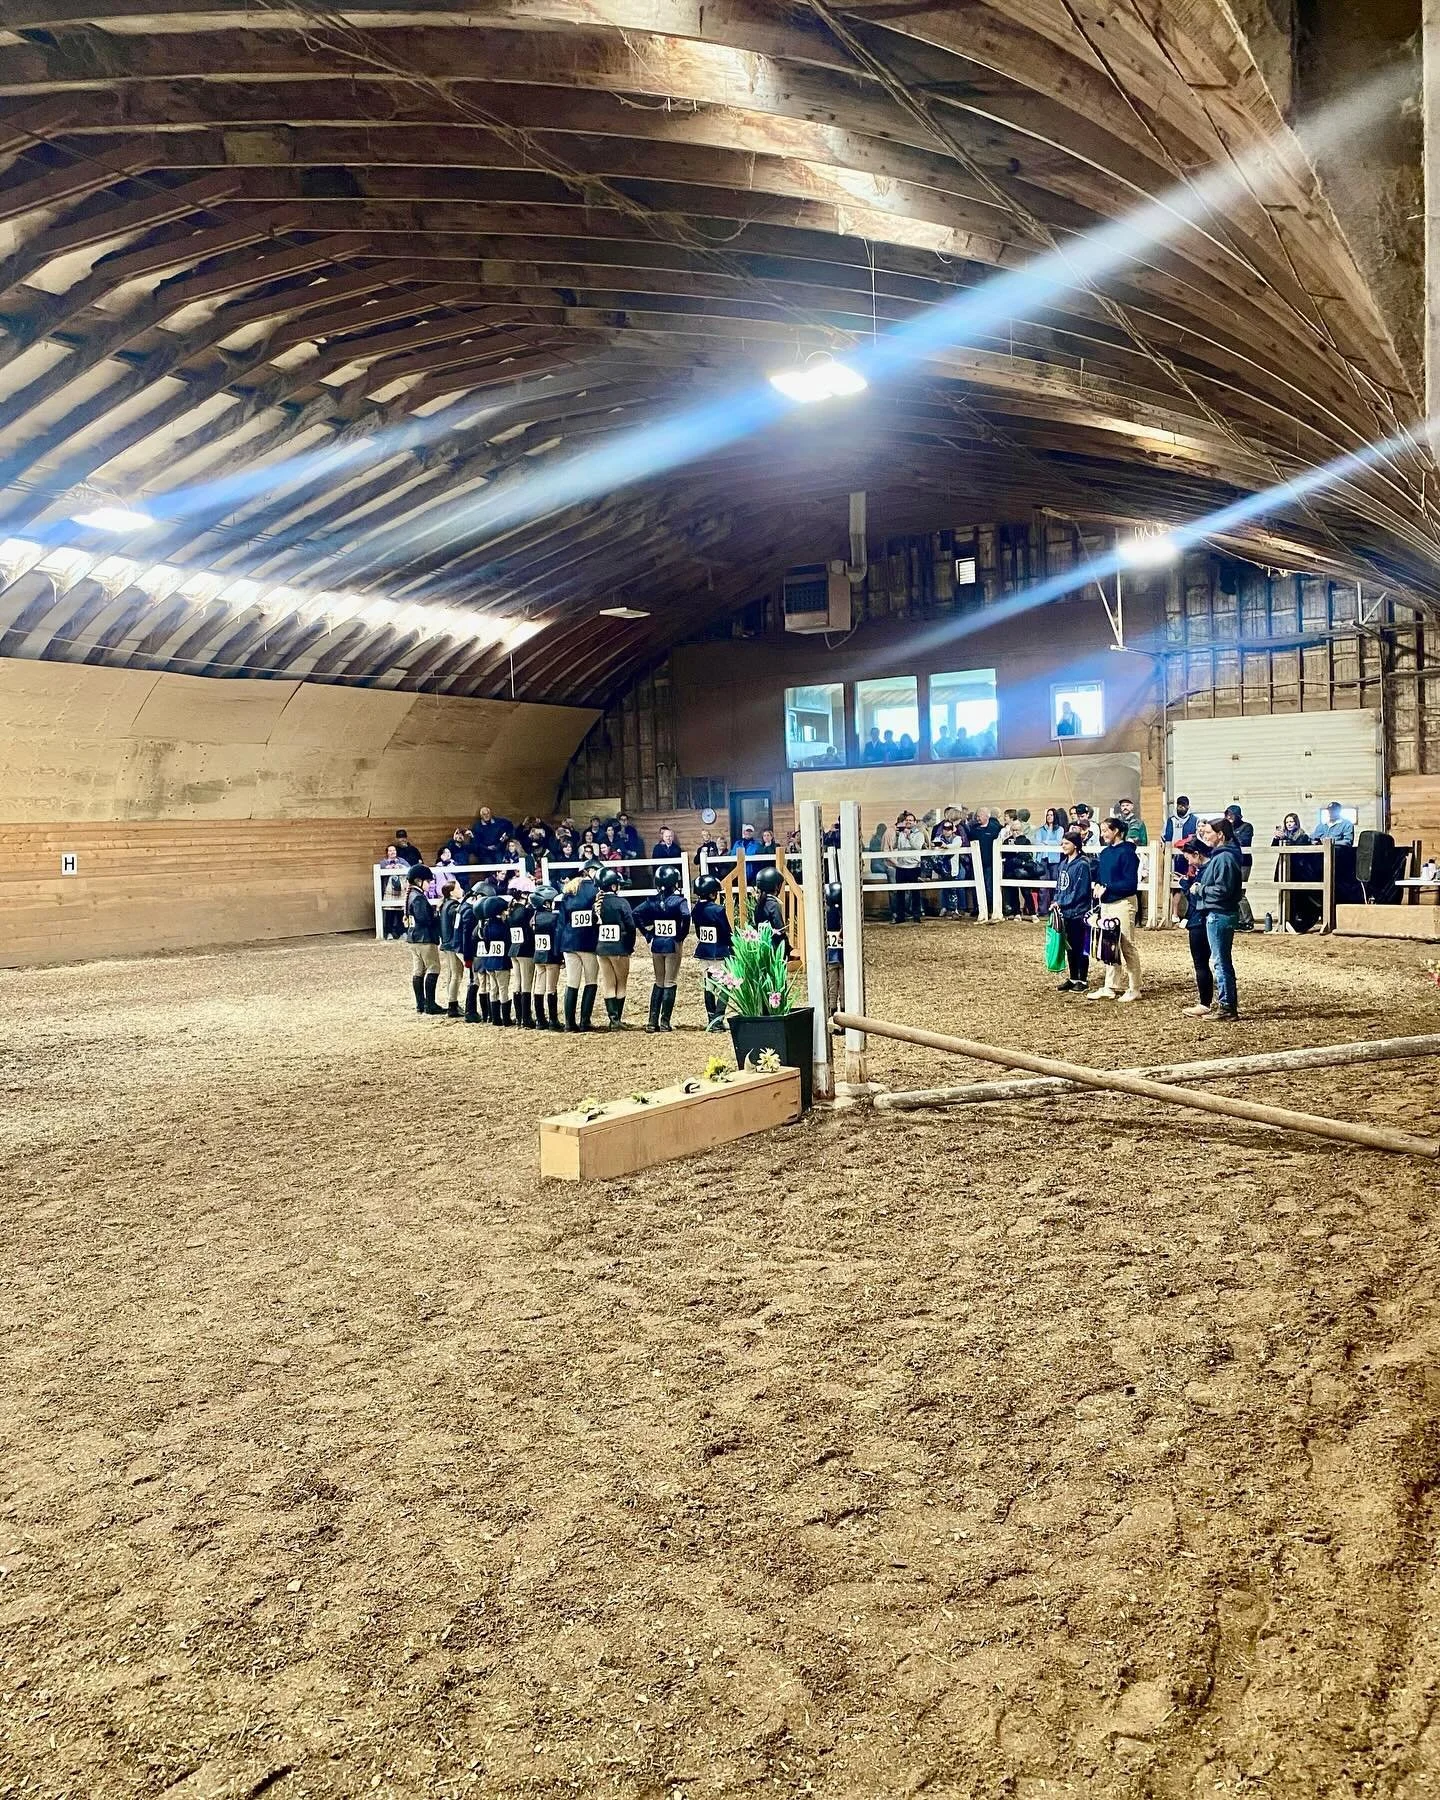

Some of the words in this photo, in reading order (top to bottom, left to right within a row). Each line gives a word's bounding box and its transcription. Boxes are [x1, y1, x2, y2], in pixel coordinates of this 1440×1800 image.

[64, 856, 75, 871] H
[574, 913, 591, 925] 509
[601, 927, 616, 940] 421
[657, 923, 673, 935] 326
